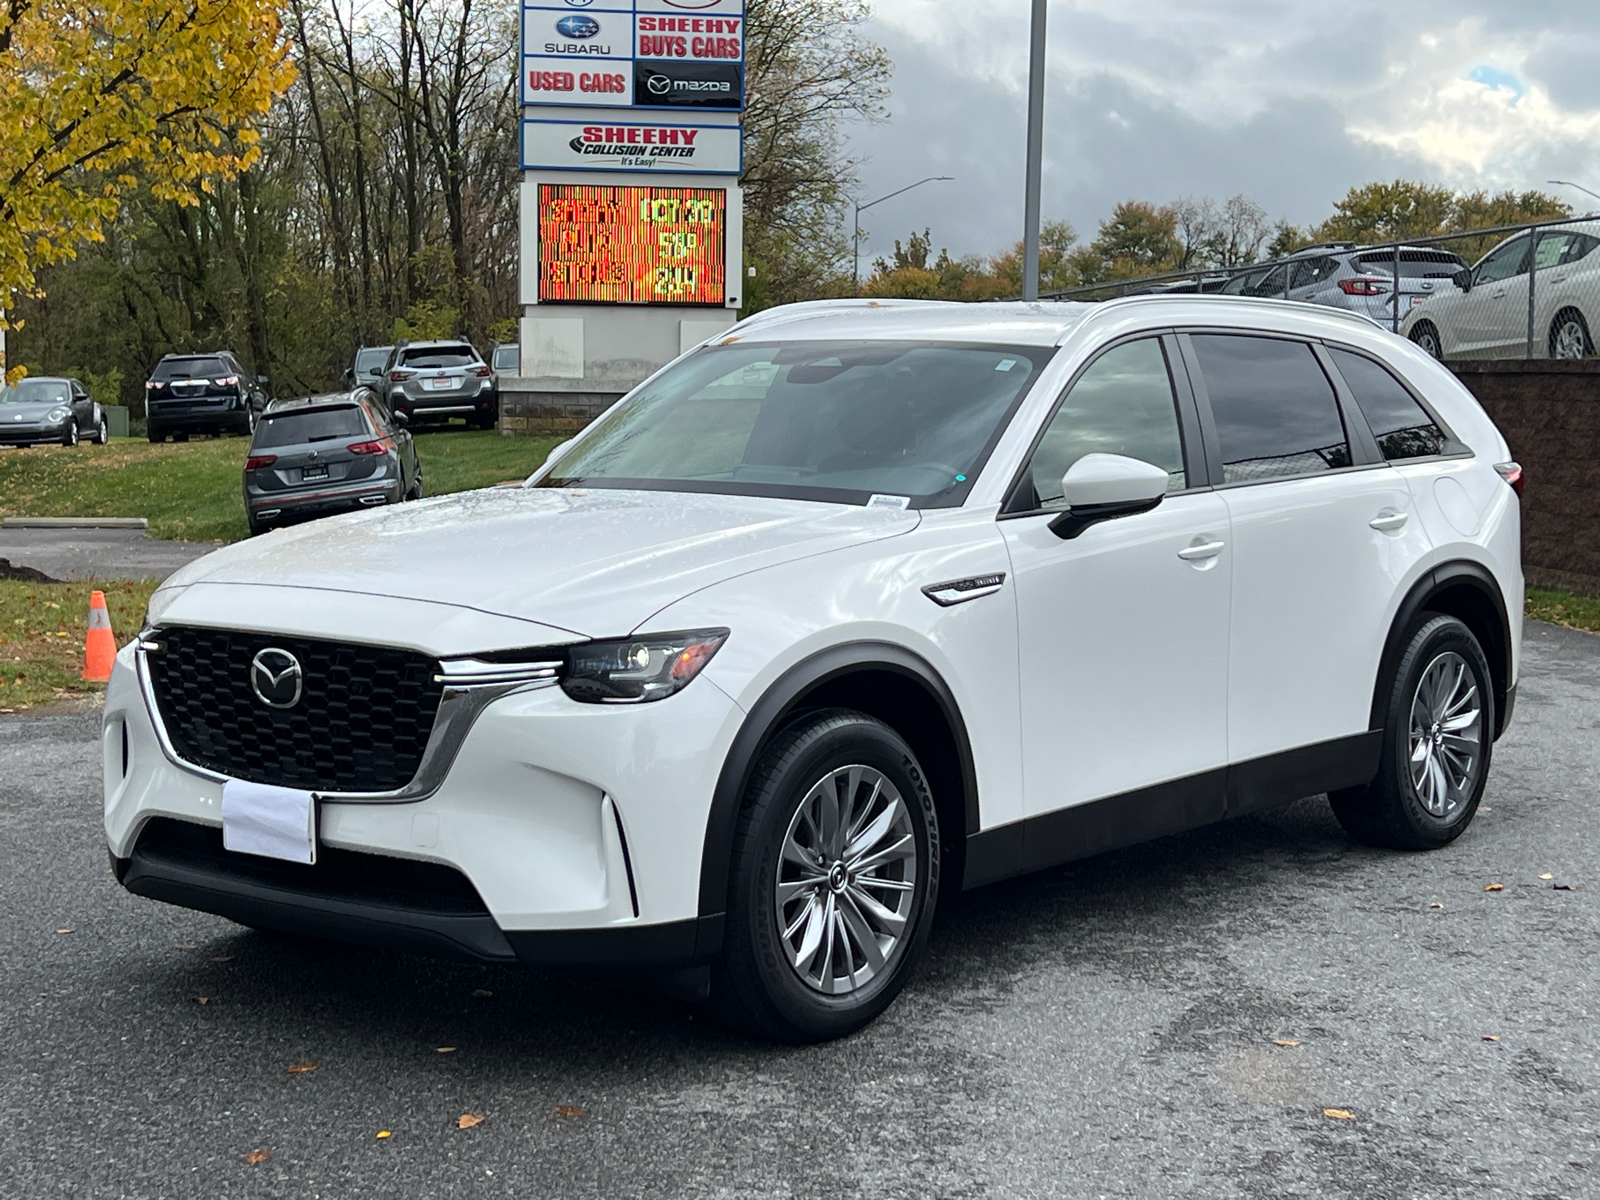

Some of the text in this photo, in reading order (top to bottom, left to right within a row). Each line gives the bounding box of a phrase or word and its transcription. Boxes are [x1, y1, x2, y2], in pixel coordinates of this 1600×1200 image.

[639, 16, 740, 34] SHEEHY
[544, 43, 611, 55] SUBARU
[639, 35, 740, 59] BUYS CARS
[529, 70, 625, 93] USED CARS
[673, 80, 731, 92] mazda
[582, 126, 699, 145] SHEEHY
[583, 143, 696, 158] COLLISION CENTER
[621, 156, 657, 168] It's Easy!
[901, 753, 932, 812] TOYO
